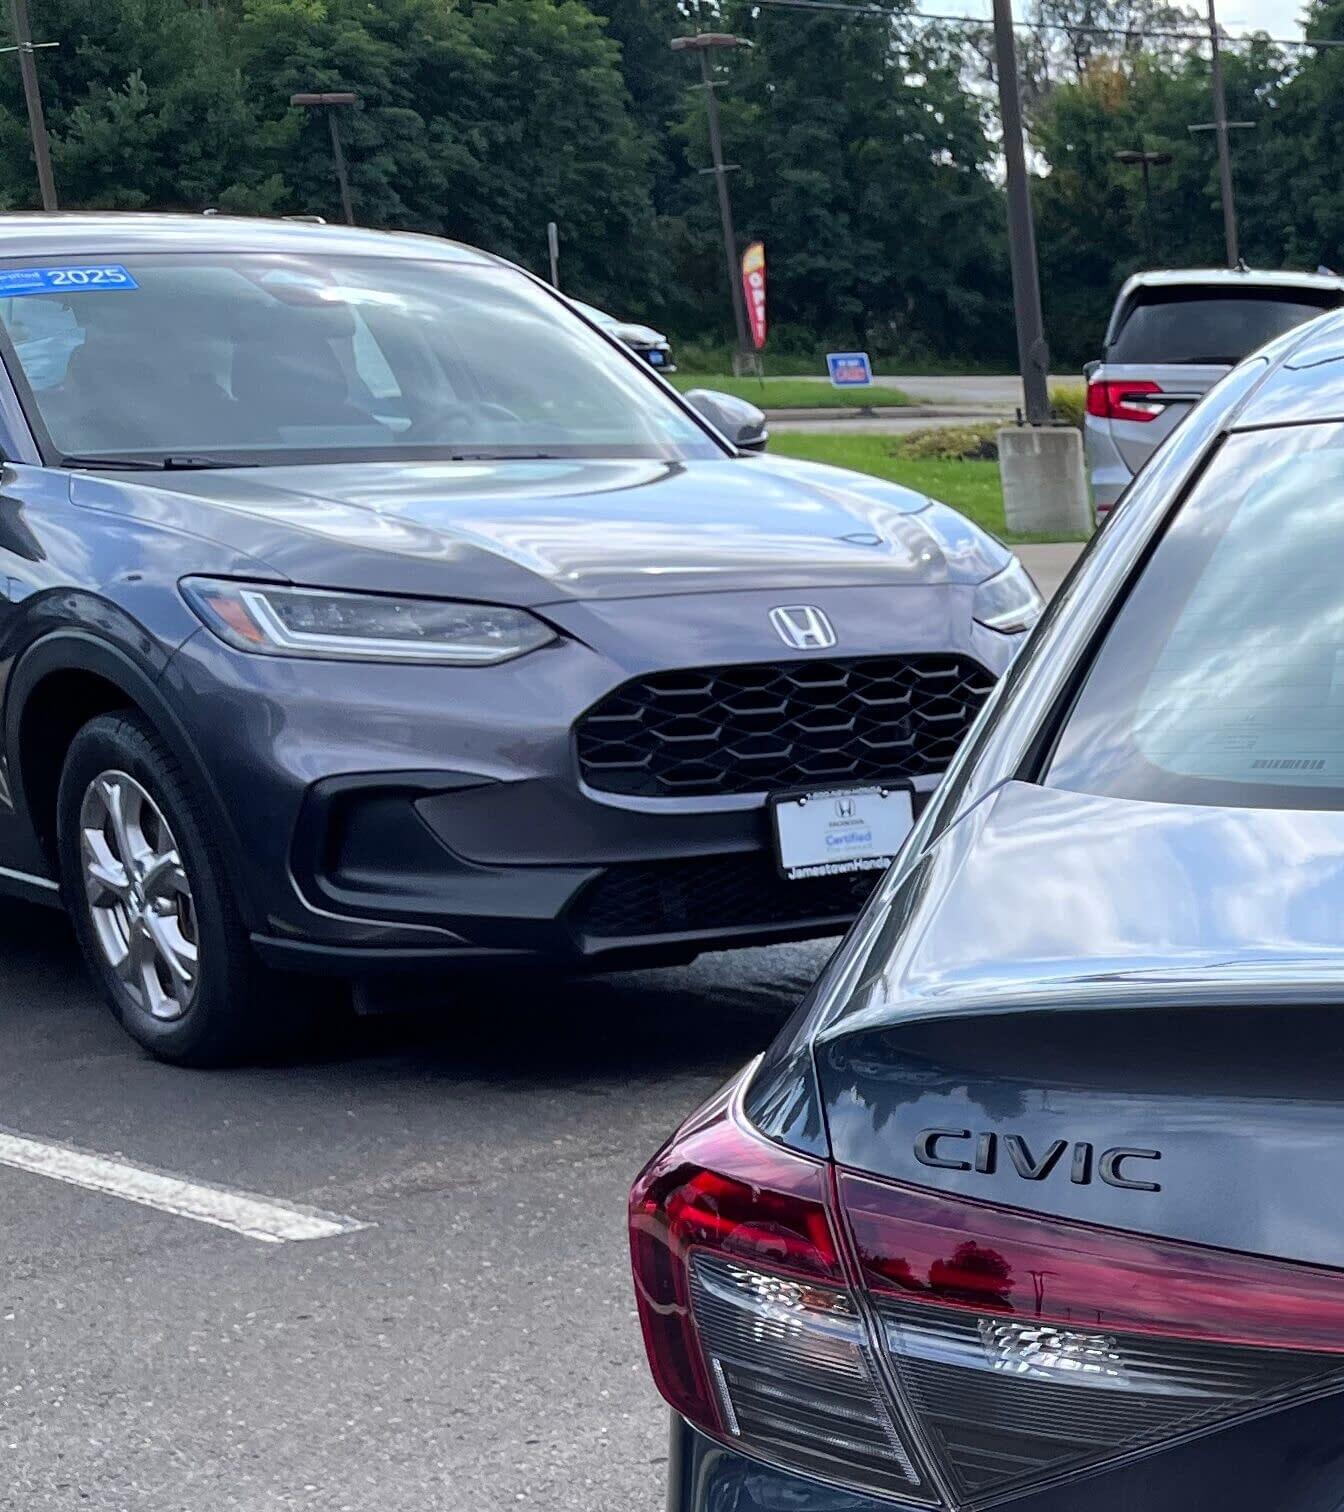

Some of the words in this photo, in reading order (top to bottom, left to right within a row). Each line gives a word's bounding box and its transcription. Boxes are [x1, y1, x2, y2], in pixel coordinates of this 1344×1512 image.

[47, 268, 127, 286] 2025
[826, 832, 871, 844] Certified
[913, 1127, 1161, 1192] CIVIC
